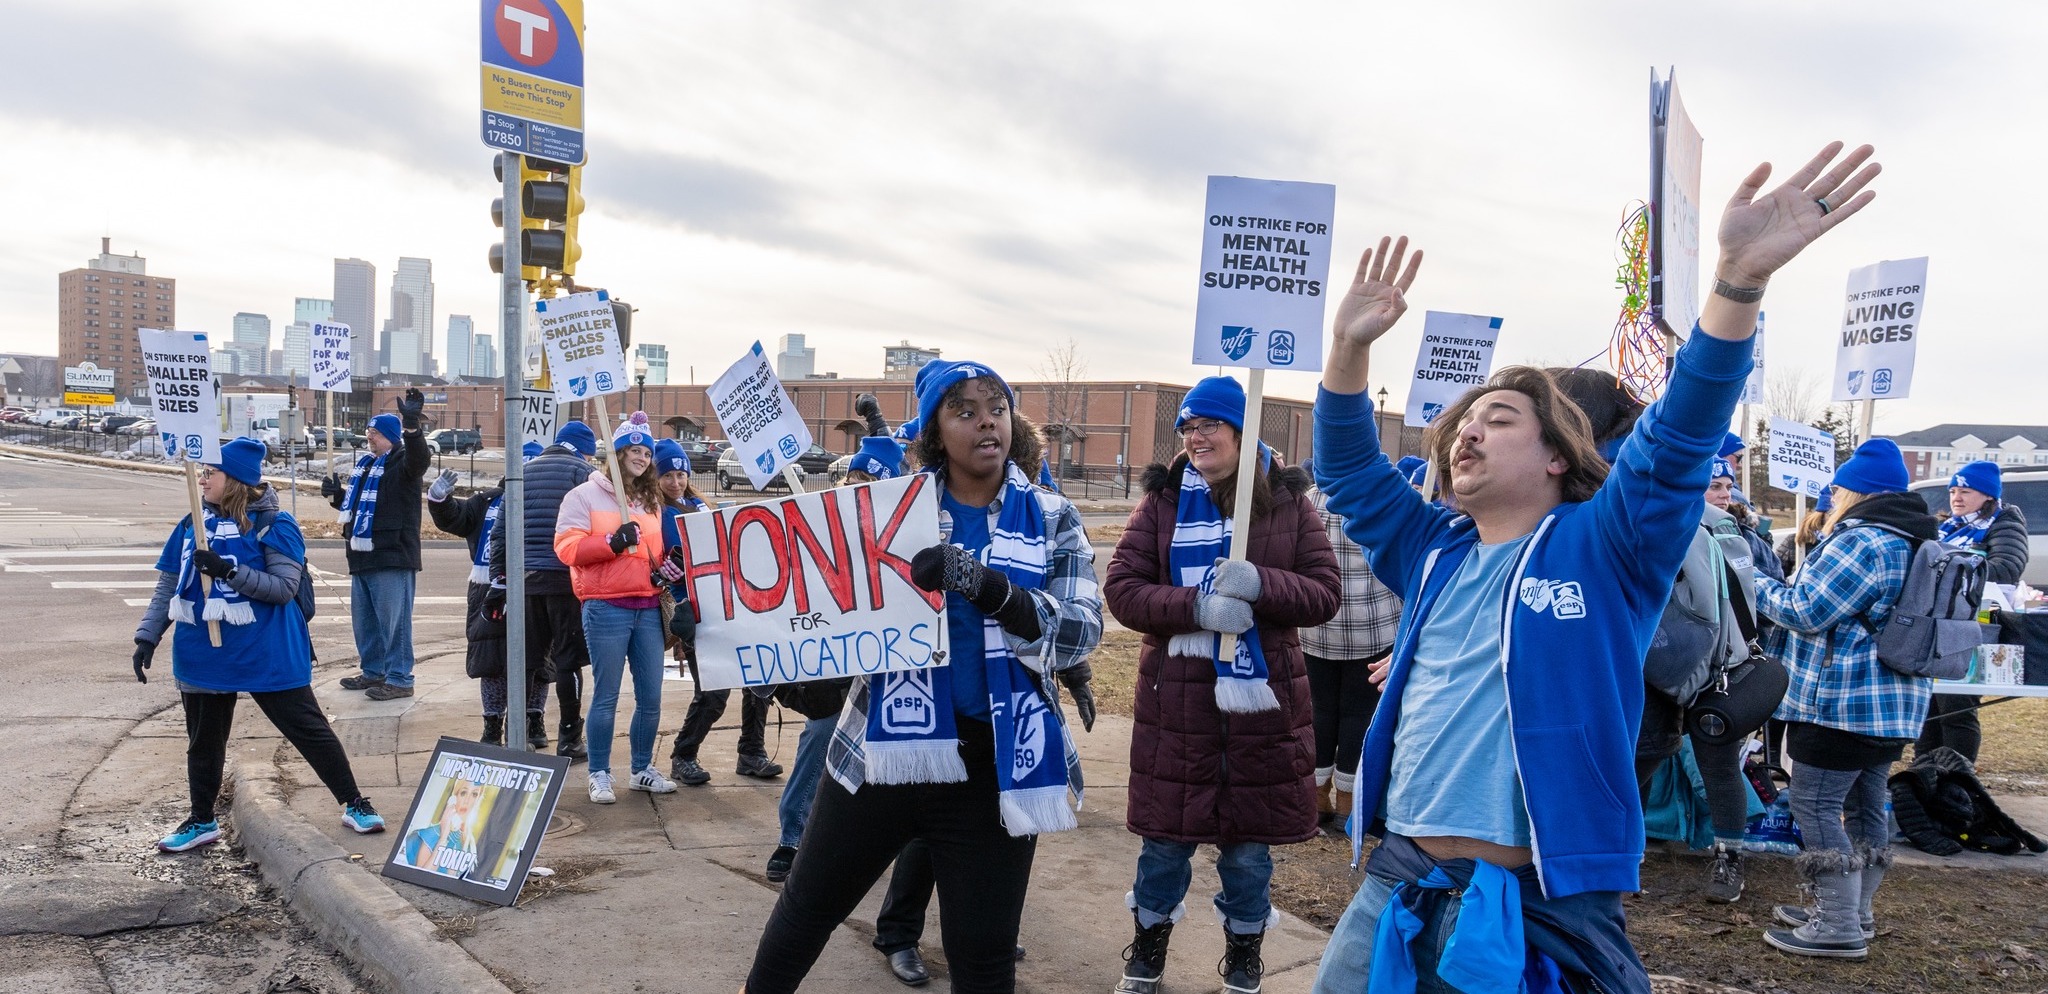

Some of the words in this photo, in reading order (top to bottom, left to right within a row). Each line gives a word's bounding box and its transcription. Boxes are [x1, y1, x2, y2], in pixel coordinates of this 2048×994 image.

[504, 5, 549, 57] T
[493, 74, 505, 84] No
[508, 77, 532, 90] Buses
[535, 84, 572, 100] Currently
[500, 87, 524, 98] Serve
[528, 93, 544, 103] This
[546, 98, 565, 109] Stop
[498, 119, 514, 131] Stop
[532, 125, 556, 136] NexTrip
[488, 130, 521, 146] 17850
[1209, 214, 1234, 227] ON
[1237, 216, 1291, 232] STRIKE
[1295, 221, 1327, 235] FOR
[1222, 233, 1310, 256] MENTAL
[1222, 253, 1306, 275] HEALTH
[1203, 272, 1321, 297] SUPPORTS
[1848, 293, 1859, 302] ON
[1861, 288, 1894, 300] STRIKE
[1896, 285, 1920, 295] FOR
[543, 318, 557, 326] ON
[558, 311, 590, 324] STRIKE
[591, 308, 609, 316] FOR
[1846, 302, 1914, 326] LIVING
[314, 324, 349, 337] BETTER
[545, 319, 612, 340] SMALLER
[1843, 324, 1914, 347] WAGES
[324, 338, 341, 348] PAY
[559, 332, 605, 350] CLASS
[1426, 335, 1440, 343] ON
[1442, 336, 1474, 346] STRIKE
[1475, 339, 1493, 348] FOR
[145, 352, 153, 360] ON
[154, 353, 185, 363] STRIKE
[188, 355, 206, 364] FOR
[313, 350, 331, 358] FOR
[336, 351, 350, 360] OUR
[564, 345, 604, 362] SIZES
[1274, 349, 1288, 357] ESP
[1431, 347, 1482, 361] MENTAL
[148, 365, 208, 381] SMALLER
[327, 367, 338, 377] and
[1429, 359, 1479, 372] HEALTH
[67, 372, 113, 382] SUMMIT
[322, 368, 350, 388] TEACHERS
[1417, 370, 1485, 385] SUPPORTS
[155, 382, 200, 397] CLASS
[716, 400, 729, 412] ON
[729, 375, 754, 401] STRIKE
[756, 361, 768, 379] FOR
[720, 370, 772, 420] RECRUITMENT
[159, 398, 198, 413] SIZES
[727, 395, 773, 436] RETENTION
[770, 384, 780, 397] OF
[742, 393, 761, 412] AND
[734, 396, 781, 440] EDUCATORS
[742, 430, 754, 443] OF
[754, 407, 783, 433] COLOR
[1784, 440, 1820, 454] SAFE,
[1786, 432, 1814, 444] STRIKE
[1816, 438, 1832, 448] FOR
[1771, 454, 1832, 474] SCHOOLS
[1778, 447, 1825, 464] STABLE
[676, 474, 946, 623] HONK
[1560, 601, 1579, 609] esp
[789, 612, 830, 632] FOR
[894, 696, 924, 711] esp
[1015, 748, 1035, 769] 59
[440, 758, 469, 780] MPS
[466, 761, 528, 791] DISTRICT
[524, 771, 541, 793] IS
[1760, 818, 1800, 830] AQUAFN
